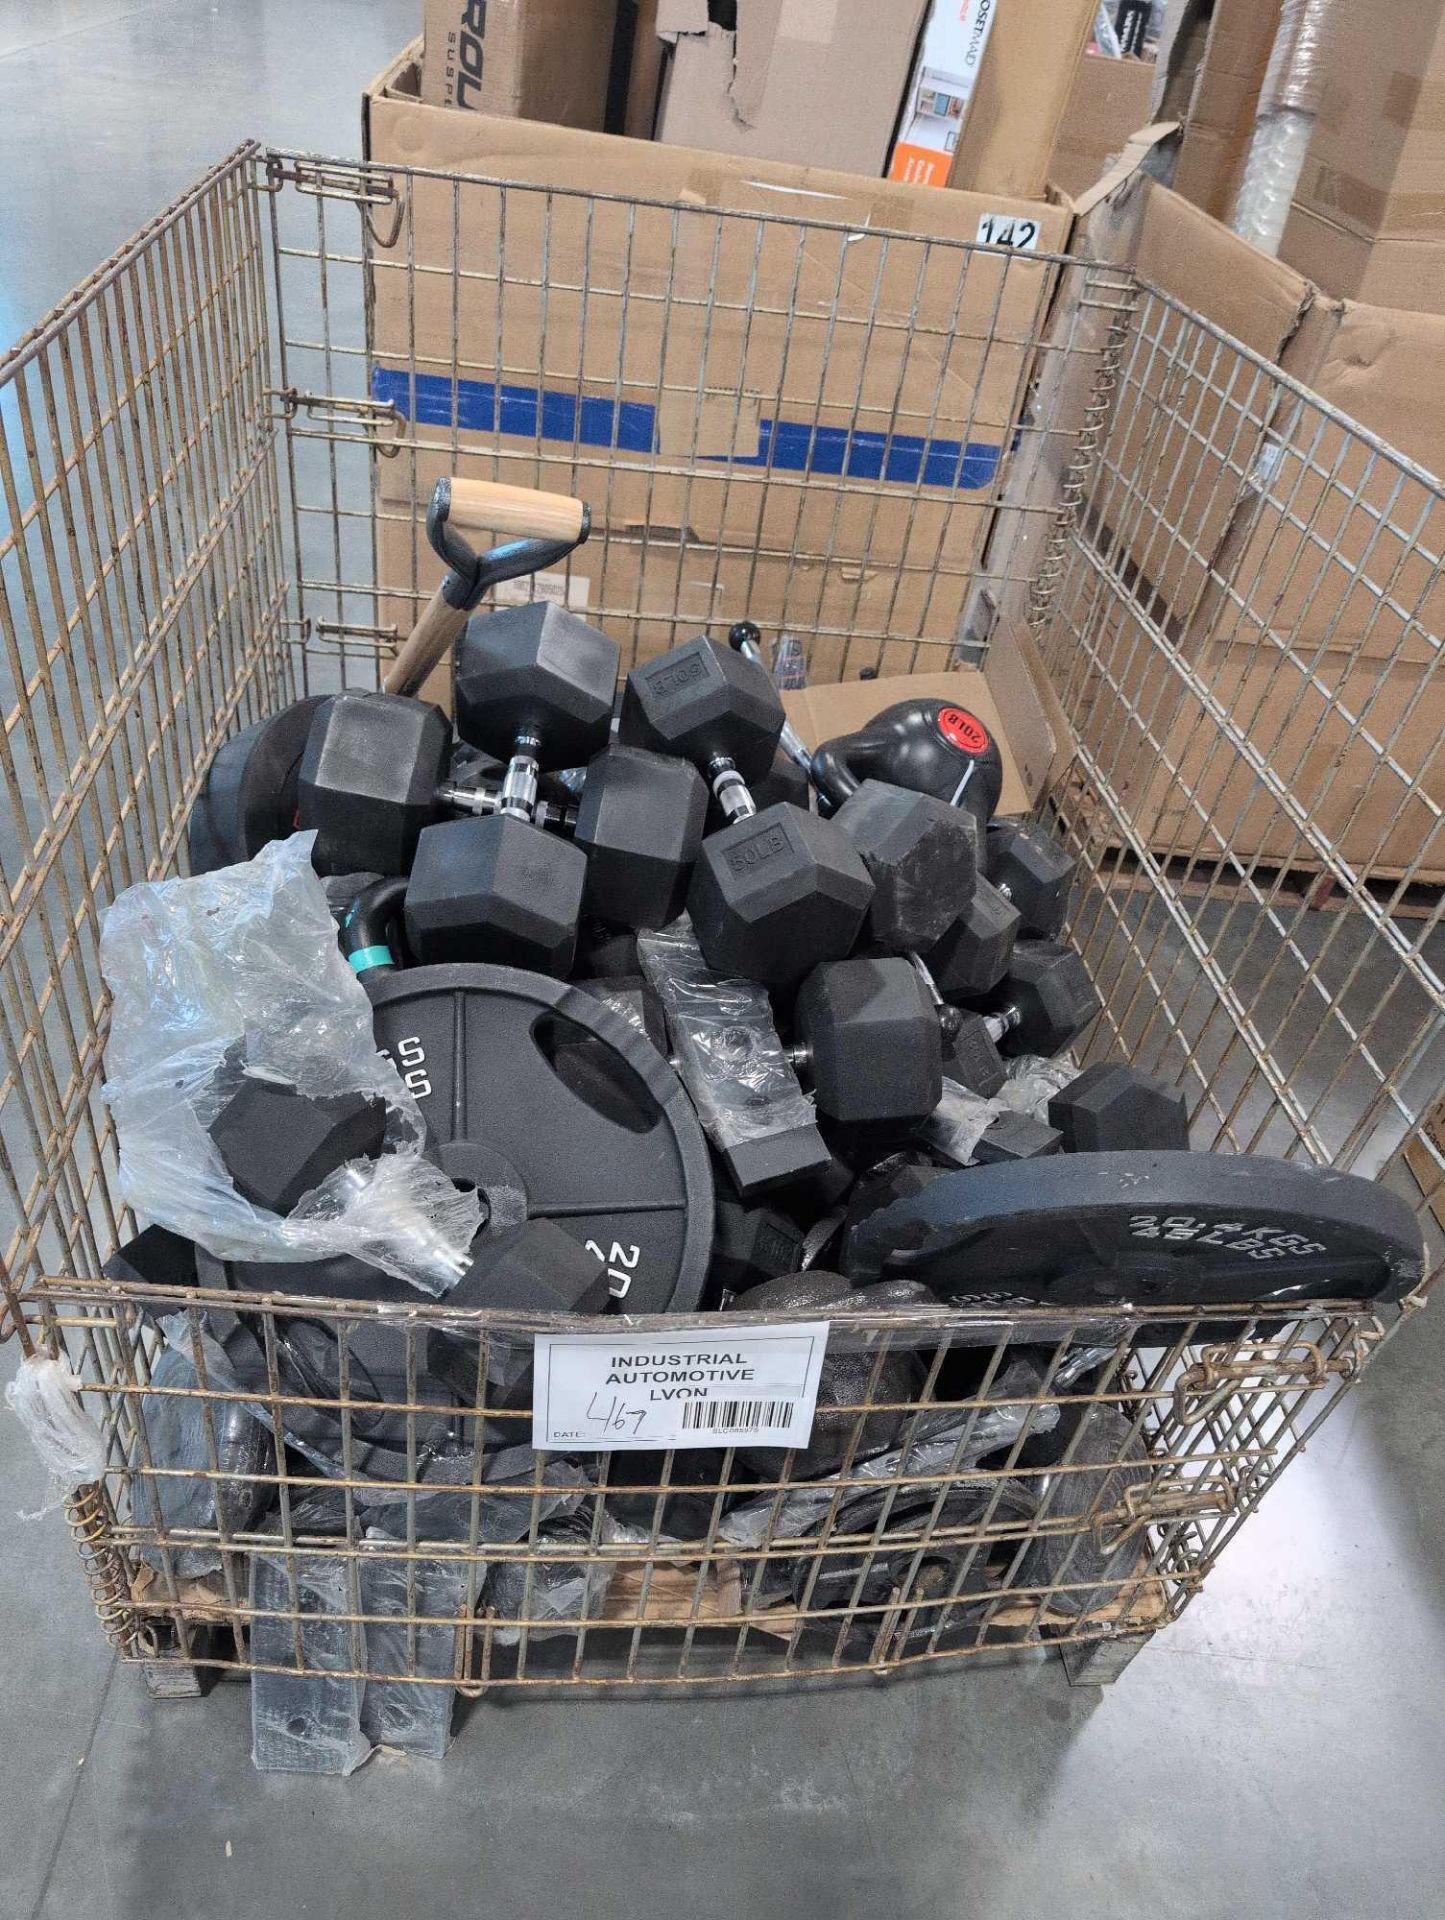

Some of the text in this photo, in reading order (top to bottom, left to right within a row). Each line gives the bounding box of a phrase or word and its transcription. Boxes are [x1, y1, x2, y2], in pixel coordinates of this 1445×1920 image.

[982, 218, 1036, 249] 142
[948, 713, 982, 743] 20LB
[1132, 1226, 1286, 1260] 45LBS
[611, 1353, 748, 1368] INDUSTRIAL
[605, 1368, 755, 1385] AUTOMOTIVE
